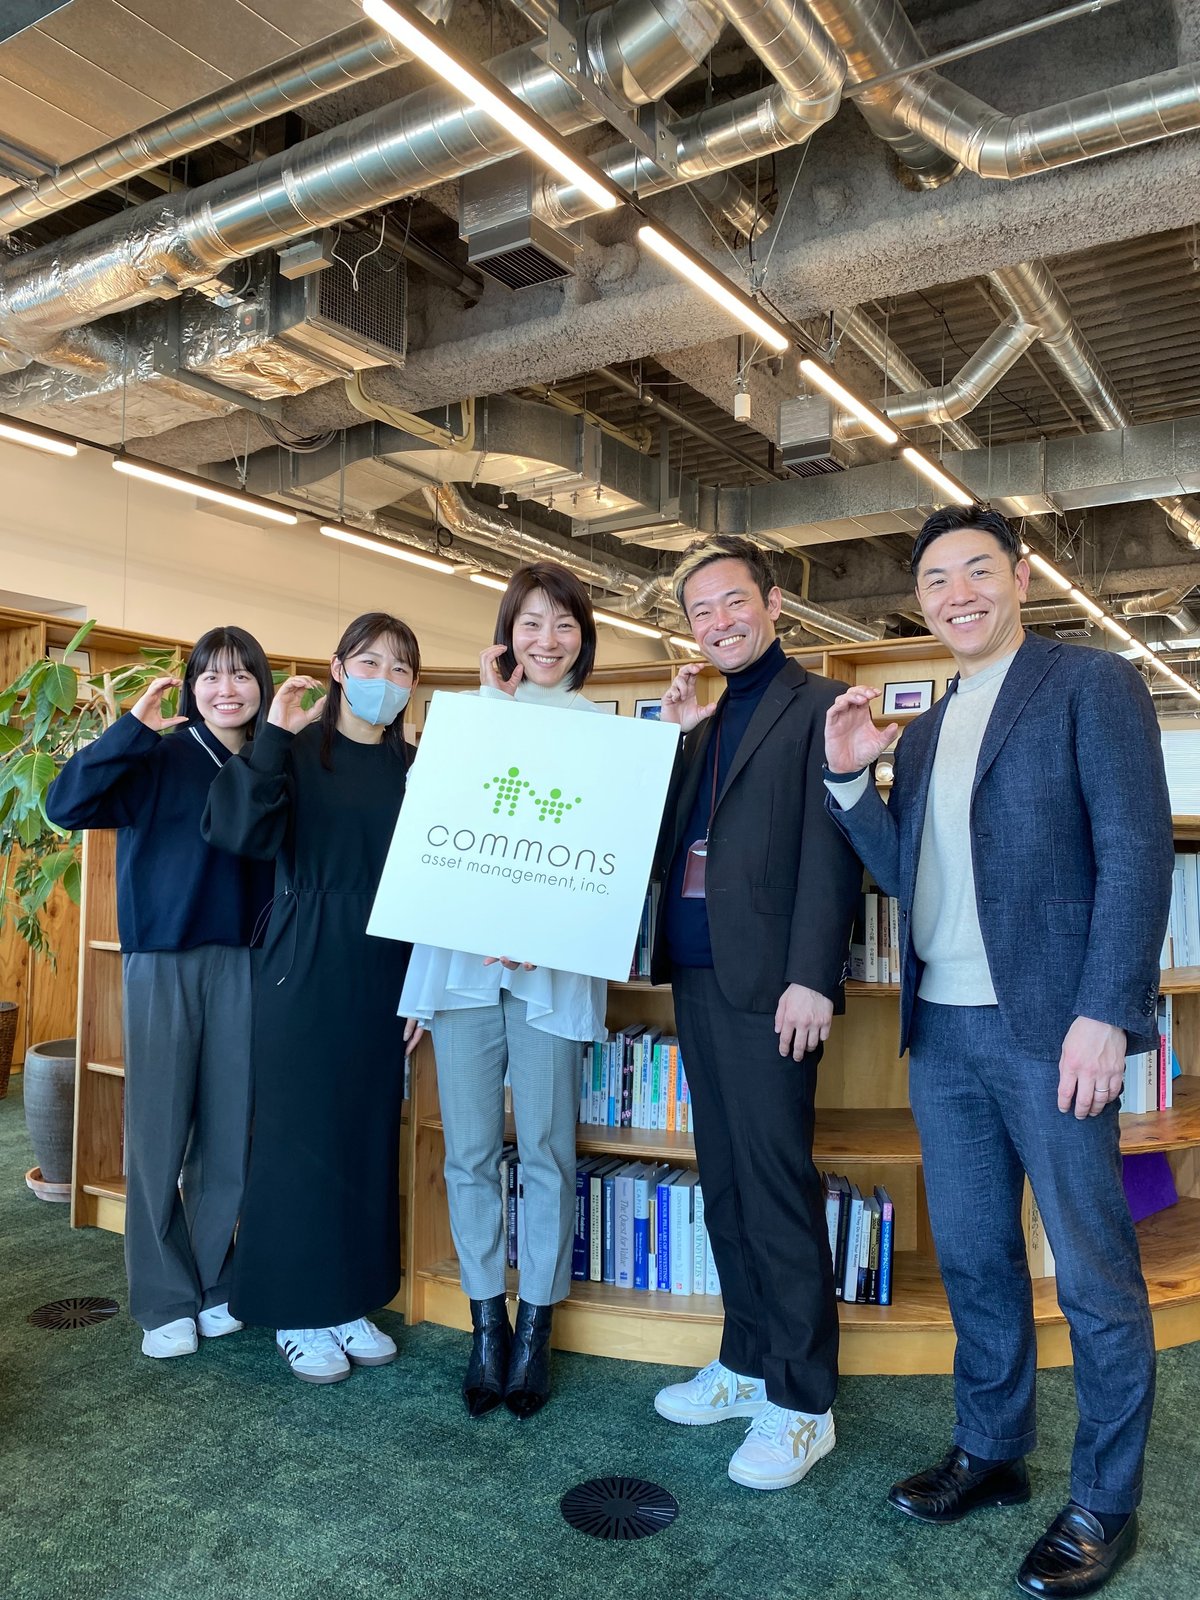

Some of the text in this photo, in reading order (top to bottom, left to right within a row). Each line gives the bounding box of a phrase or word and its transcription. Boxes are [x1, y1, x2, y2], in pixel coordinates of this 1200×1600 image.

[427, 825, 616, 875] commons
[421, 853, 462, 869] asset
[580, 877, 610, 895] inc.
[620, 1200, 628, 1213] The
[620, 1214, 628, 1235] Quest
[620, 1236, 628, 1247] for
[620, 1247, 628, 1266] Value
